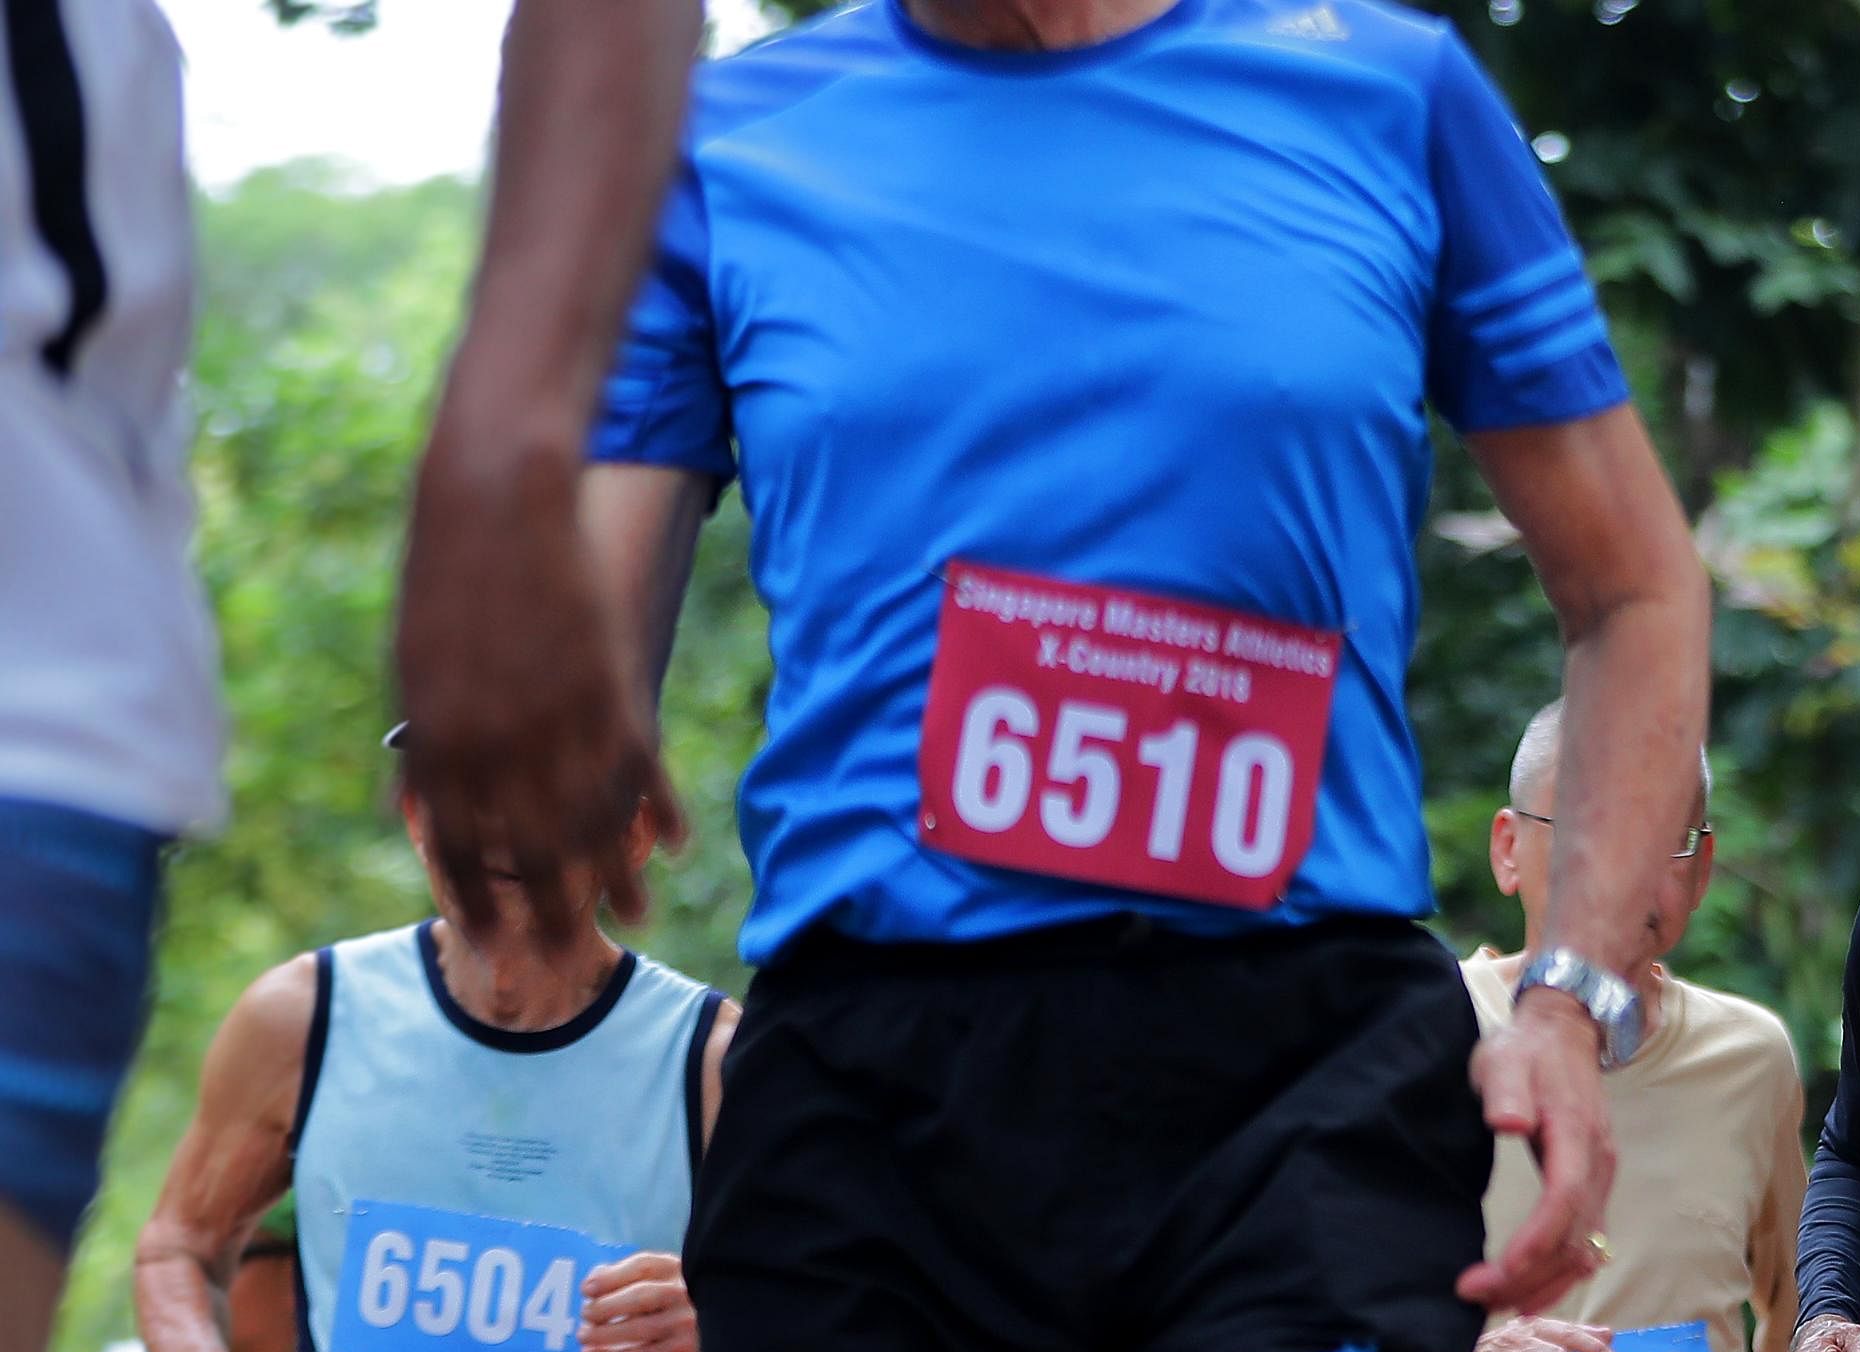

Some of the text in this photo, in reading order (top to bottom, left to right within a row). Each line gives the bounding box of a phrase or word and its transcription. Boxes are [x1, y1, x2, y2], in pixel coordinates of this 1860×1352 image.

[955, 572, 1097, 631] Singapore
[1103, 599, 1220, 653] Masters
[1037, 632, 1180, 695] X-Country
[952, 686, 1294, 878] 6510
